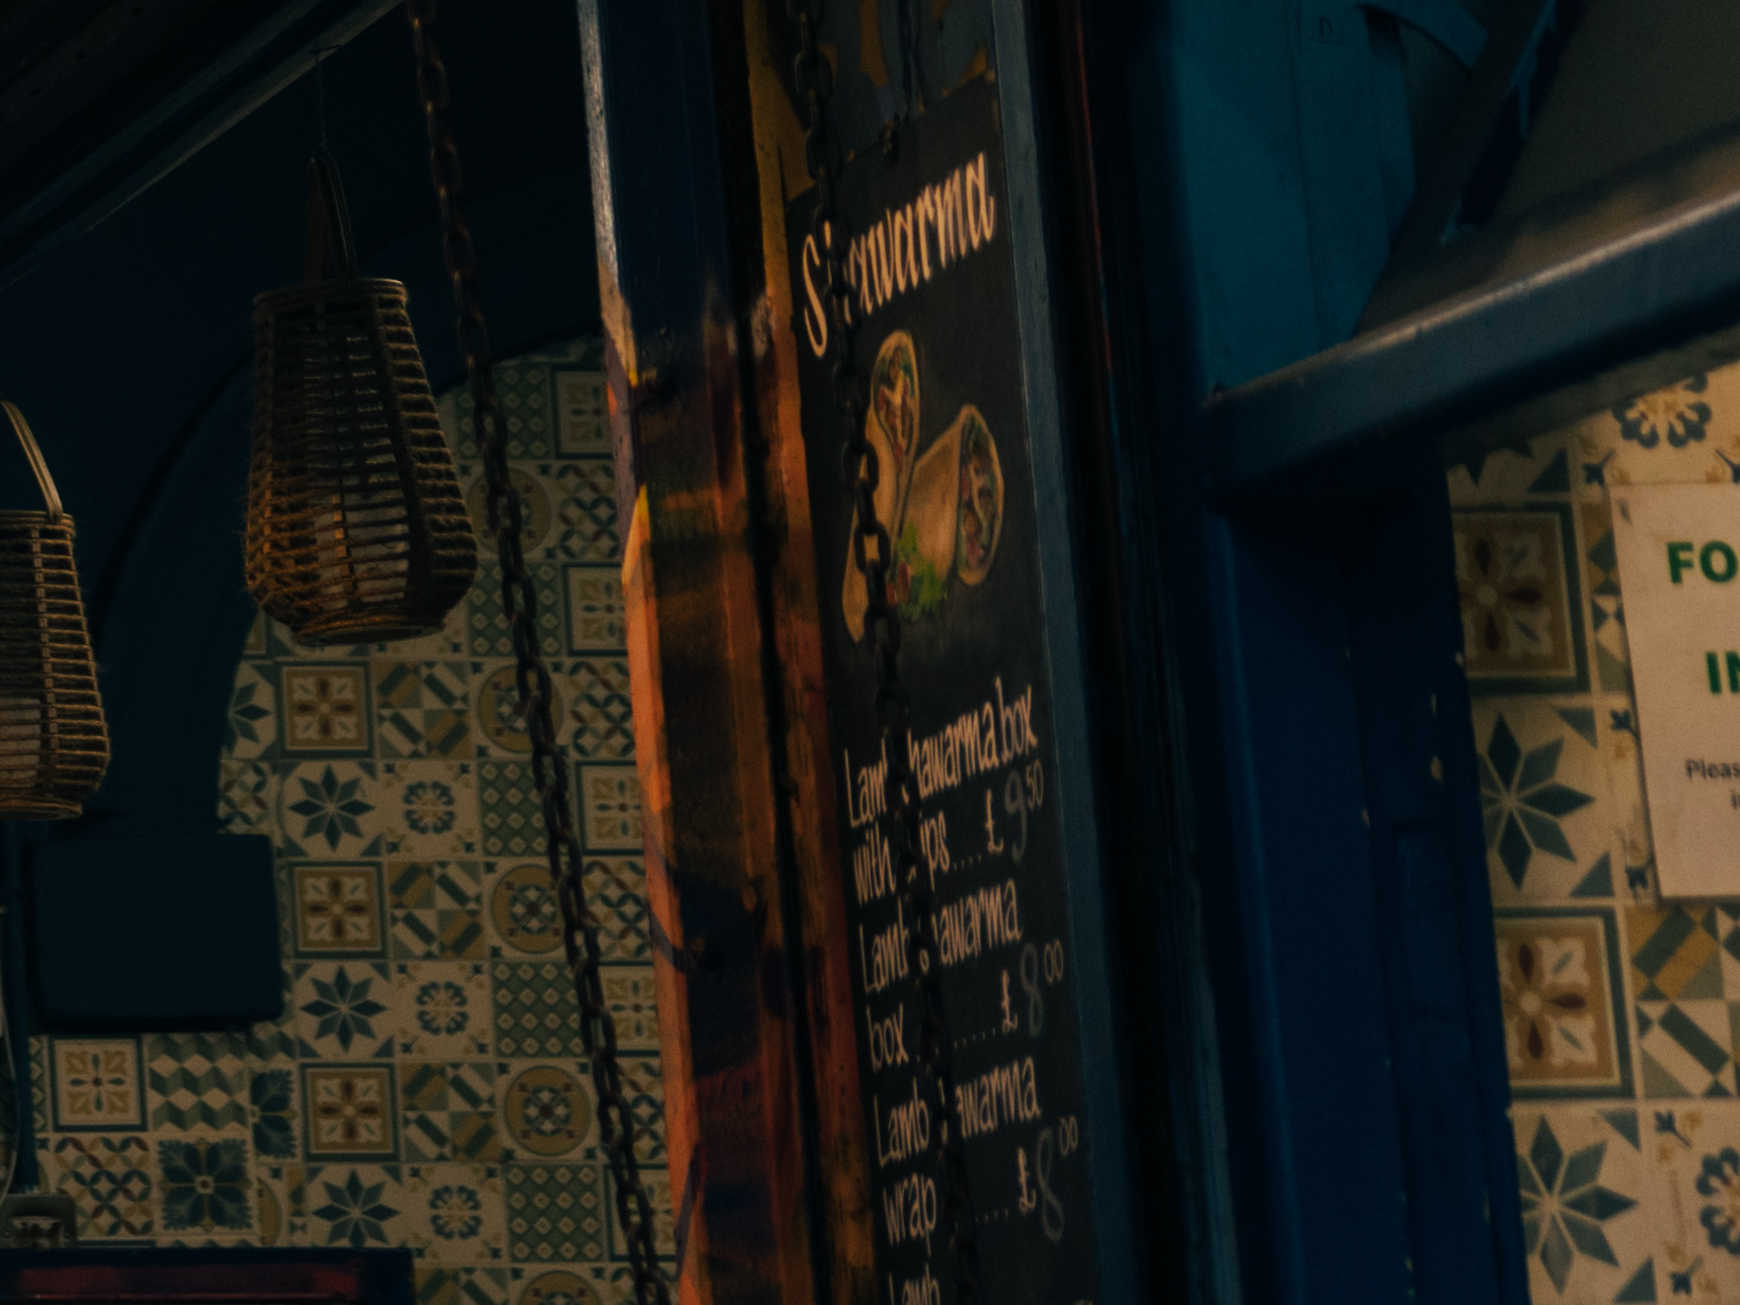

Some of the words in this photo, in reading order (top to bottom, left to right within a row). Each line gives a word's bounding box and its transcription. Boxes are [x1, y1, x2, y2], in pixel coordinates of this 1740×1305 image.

[901, 699, 999, 807] hawarma
[866, 1001, 910, 1074] box
[874, 1075, 931, 1169] Lamb
[883, 1172, 937, 1258] wrap
